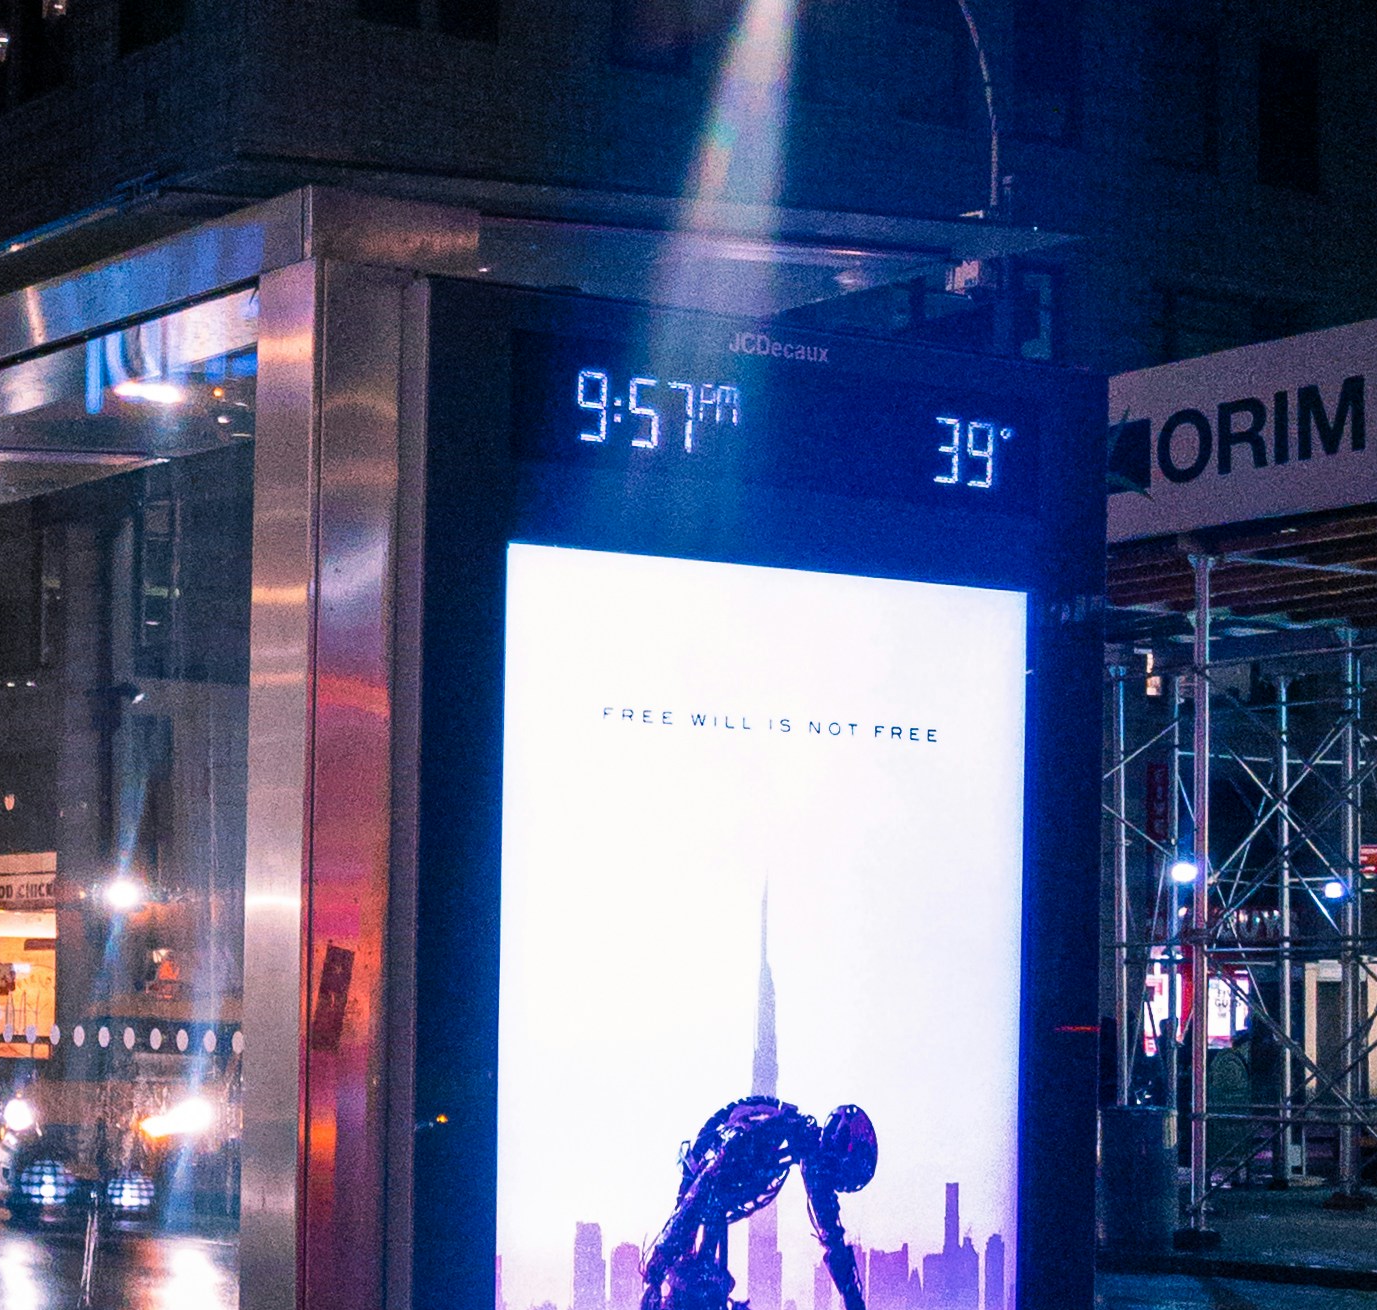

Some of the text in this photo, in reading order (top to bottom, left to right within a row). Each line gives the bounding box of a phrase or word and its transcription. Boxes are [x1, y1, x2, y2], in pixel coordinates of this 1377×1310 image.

[729, 331, 830, 363] JCDecaux
[603, 706, 938, 743] FREE WILL IS NOT FREE
